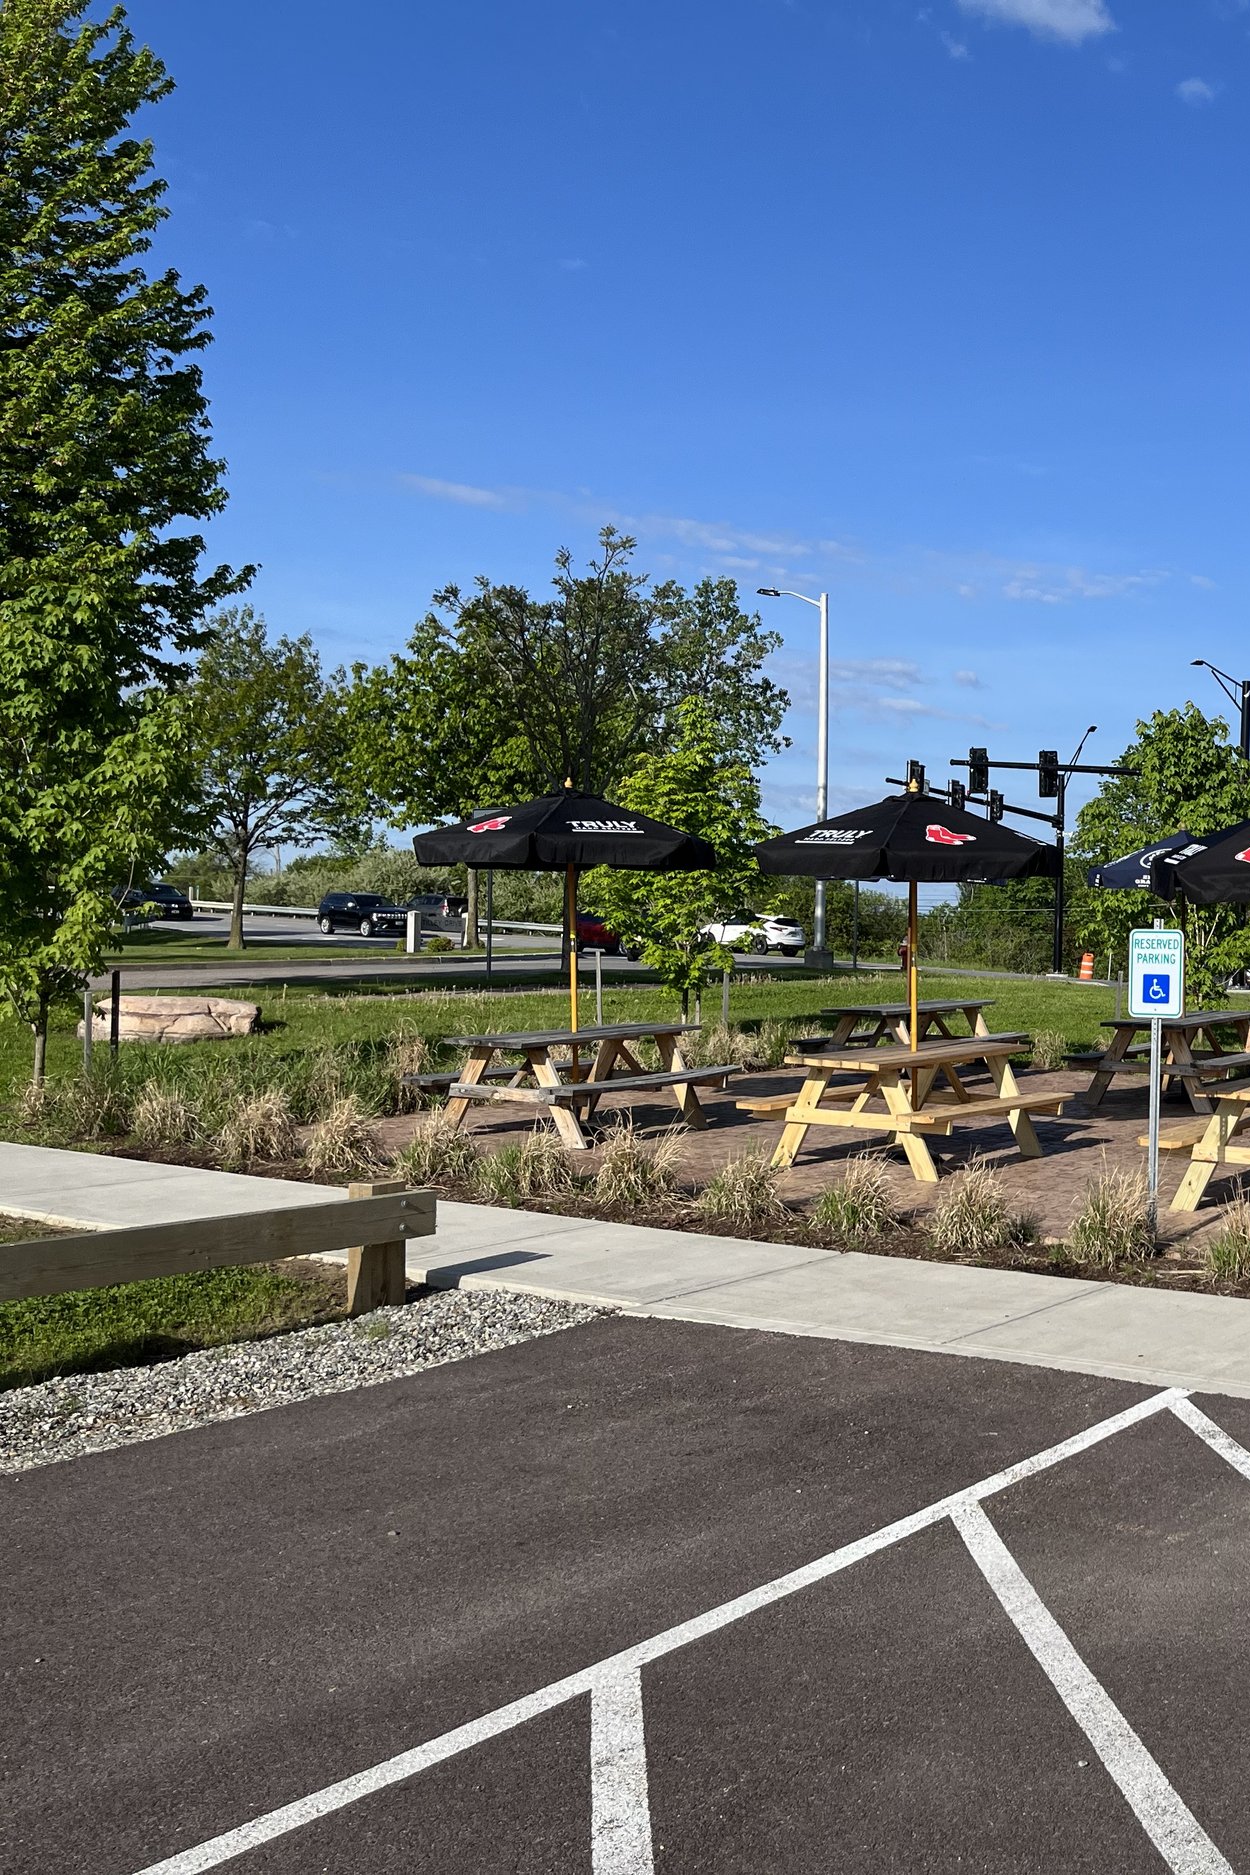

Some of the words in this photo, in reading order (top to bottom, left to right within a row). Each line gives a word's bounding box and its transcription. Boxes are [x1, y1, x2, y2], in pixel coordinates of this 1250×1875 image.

[809, 830, 874, 838] TRULY
[1134, 938, 1180, 950] RESERVED
[1136, 953, 1176, 965] PARKING
